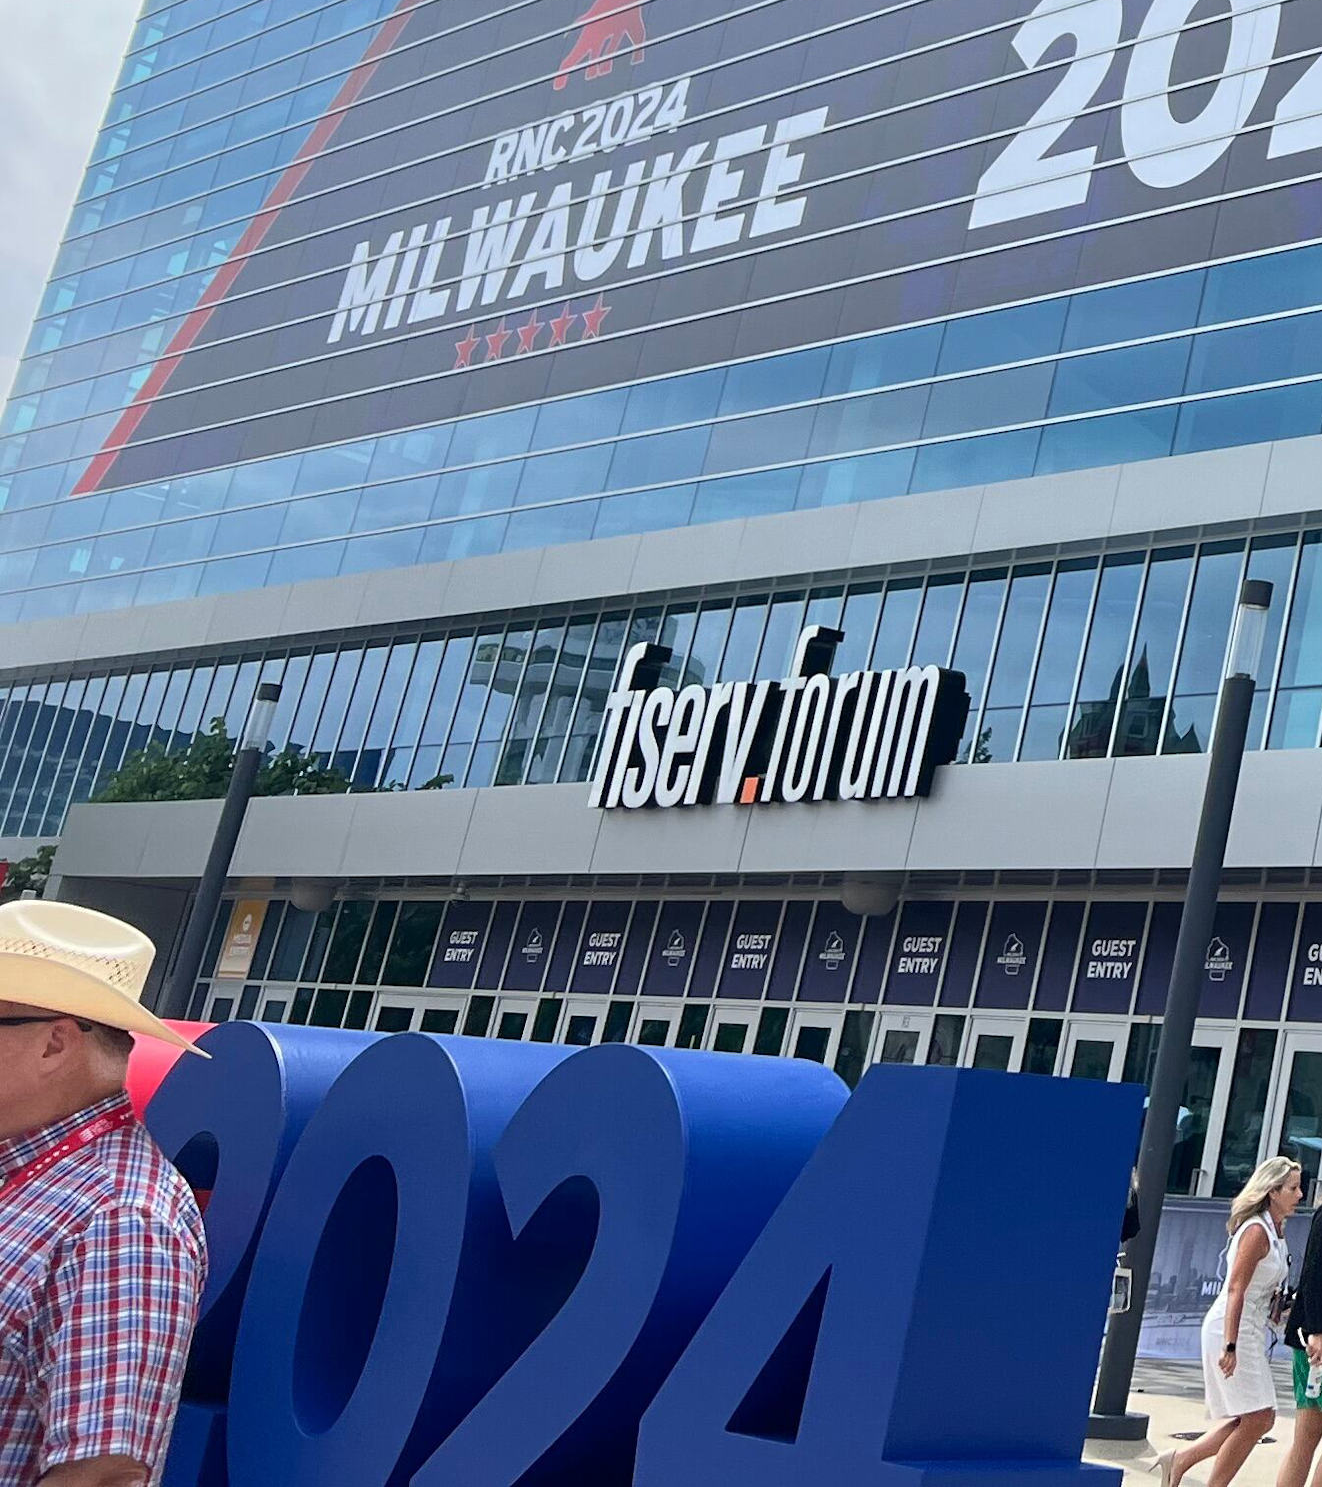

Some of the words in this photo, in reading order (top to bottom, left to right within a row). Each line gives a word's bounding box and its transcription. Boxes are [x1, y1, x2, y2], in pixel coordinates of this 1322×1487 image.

[568, 76, 692, 164] 2024
[326, 105, 829, 344] MILWAUKEE
[587, 624, 941, 809] fiserv.forum
[588, 932, 622, 948] GUEST
[735, 934, 772, 950] GUEST
[902, 936, 943, 953] GUEST
[1091, 939, 1137, 957] GUEST
[583, 951, 618, 966] ENTRY
[730, 953, 768, 970] ENTRY
[897, 956, 939, 974] ENTRY
[1086, 961, 1133, 979] ENTRY
